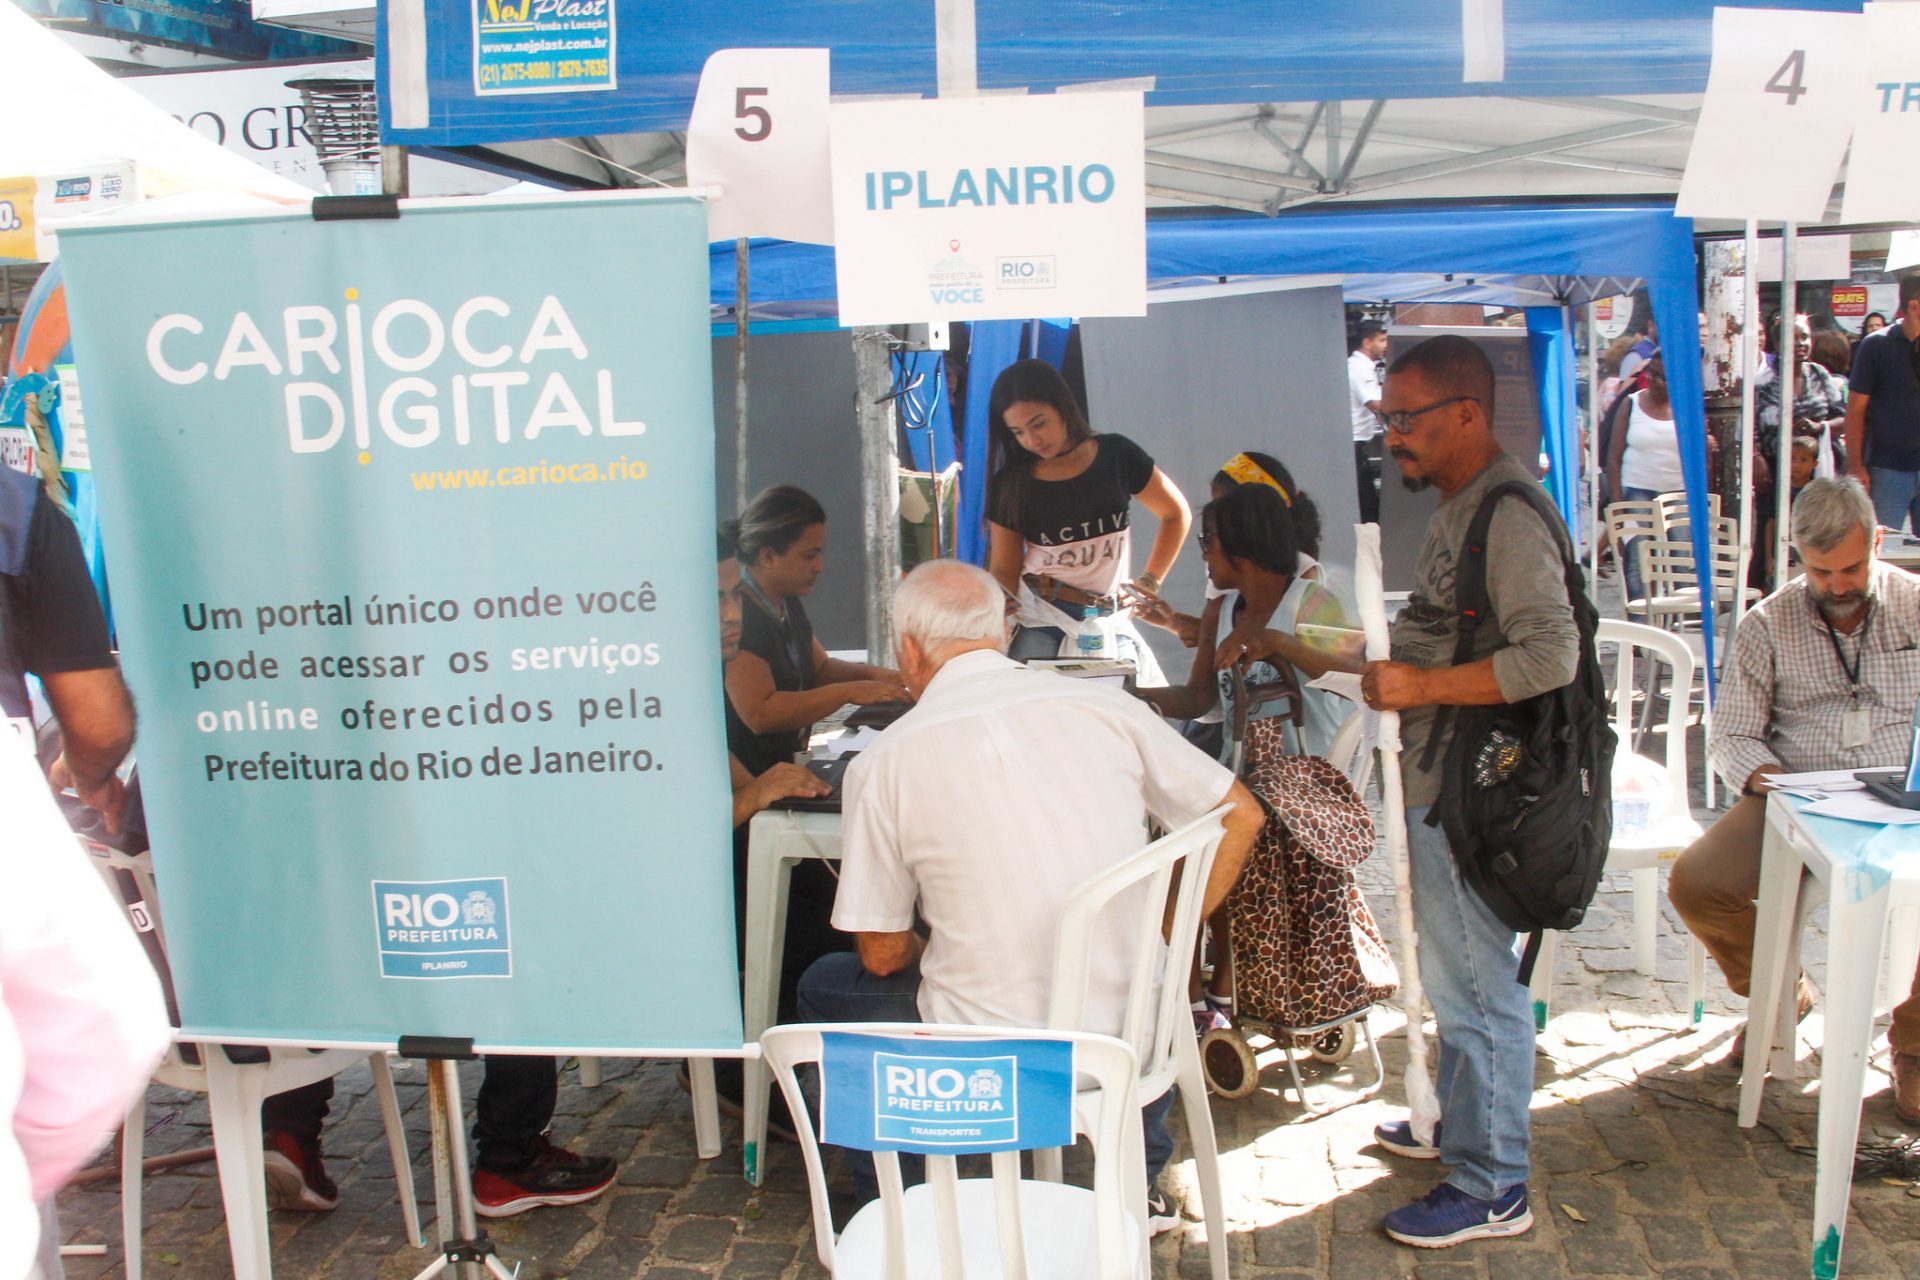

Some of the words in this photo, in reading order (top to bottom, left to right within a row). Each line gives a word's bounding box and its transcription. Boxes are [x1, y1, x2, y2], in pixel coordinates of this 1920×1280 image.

[533, 0, 606, 20] Plast
[534, 21, 562, 31] Venda
[563, 22, 570, 30] e
[571, 20, 608, 31] Locação
[481, 37, 608, 54] www.nejplast.com.br
[1764, 49, 1808, 106] 4
[734, 87, 772, 142] 5
[1875, 82, 1920, 113] TR
[865, 163, 1115, 211] IPLANRIO
[1001, 262, 1035, 278] RIO
[146, 287, 589, 385] CARIOCA
[284, 368, 647, 465] DIGITAL
[411, 454, 648, 491] www.carioca.rio
[183, 602, 243, 631] Um
[256, 595, 352, 635] portal
[365, 594, 460, 626] único
[473, 586, 563, 620] onde
[575, 580, 657, 615] você
[191, 650, 279, 689] pode
[300, 654, 425, 678] acessar
[449, 650, 489, 674] os
[511, 636, 661, 674] serviços
[196, 700, 319, 733] online
[340, 693, 553, 731] oferecidos
[578, 688, 662, 728] pela
[204, 751, 363, 782] Prefeitura
[369, 751, 409, 782] do
[417, 750, 473, 781] Rio
[480, 746, 522, 776] de
[529, 742, 663, 775] Janeiro.
[383, 892, 460, 928] RIO
[387, 927, 498, 943] PREFEITURA
[421, 960, 468, 971] IPLANRIO
[886, 1065, 965, 1099] RIO
[887, 1096, 1004, 1112] PREFEITURA
[909, 1126, 982, 1137] TRANSPORTES
